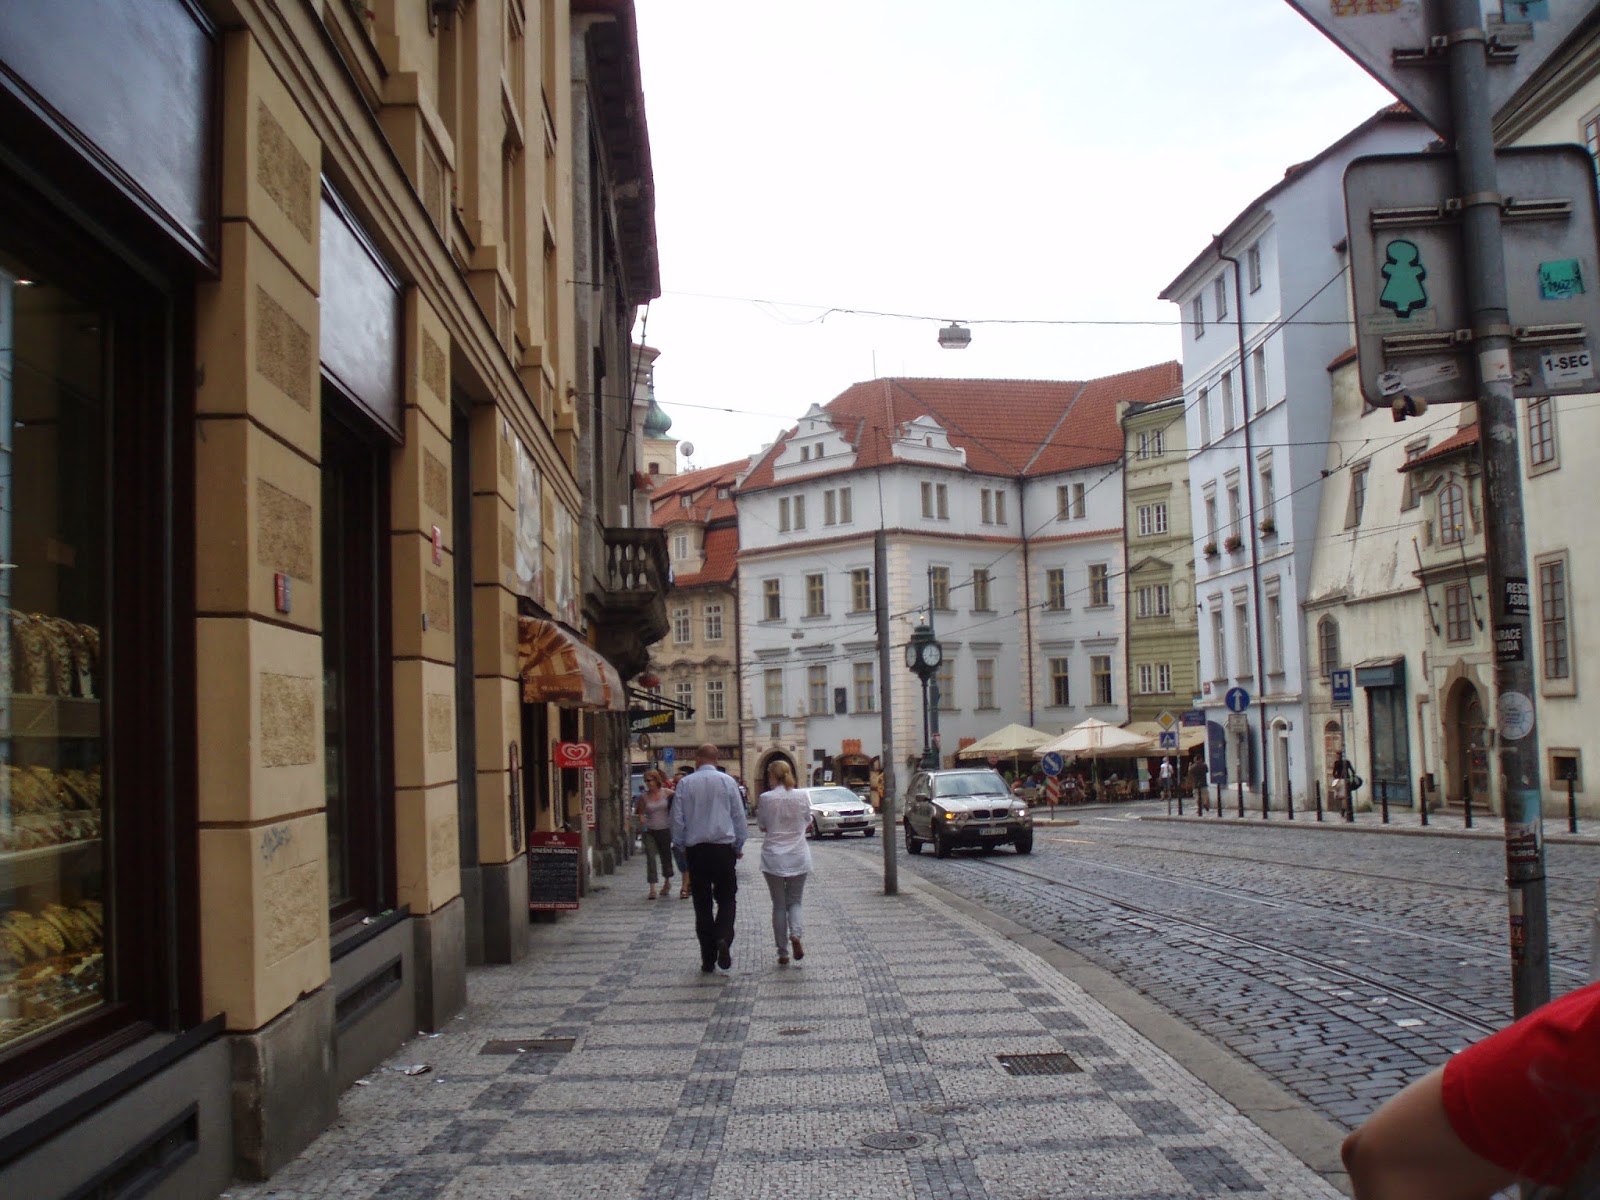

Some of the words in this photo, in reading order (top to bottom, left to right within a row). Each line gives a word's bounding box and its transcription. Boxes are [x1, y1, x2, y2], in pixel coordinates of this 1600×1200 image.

[1545, 354, 1589, 371] 1-SEC
[1334, 673, 1349, 689] H
[631, 711, 673, 730] SUBWAY
[584, 772, 594, 822] CHANGE
